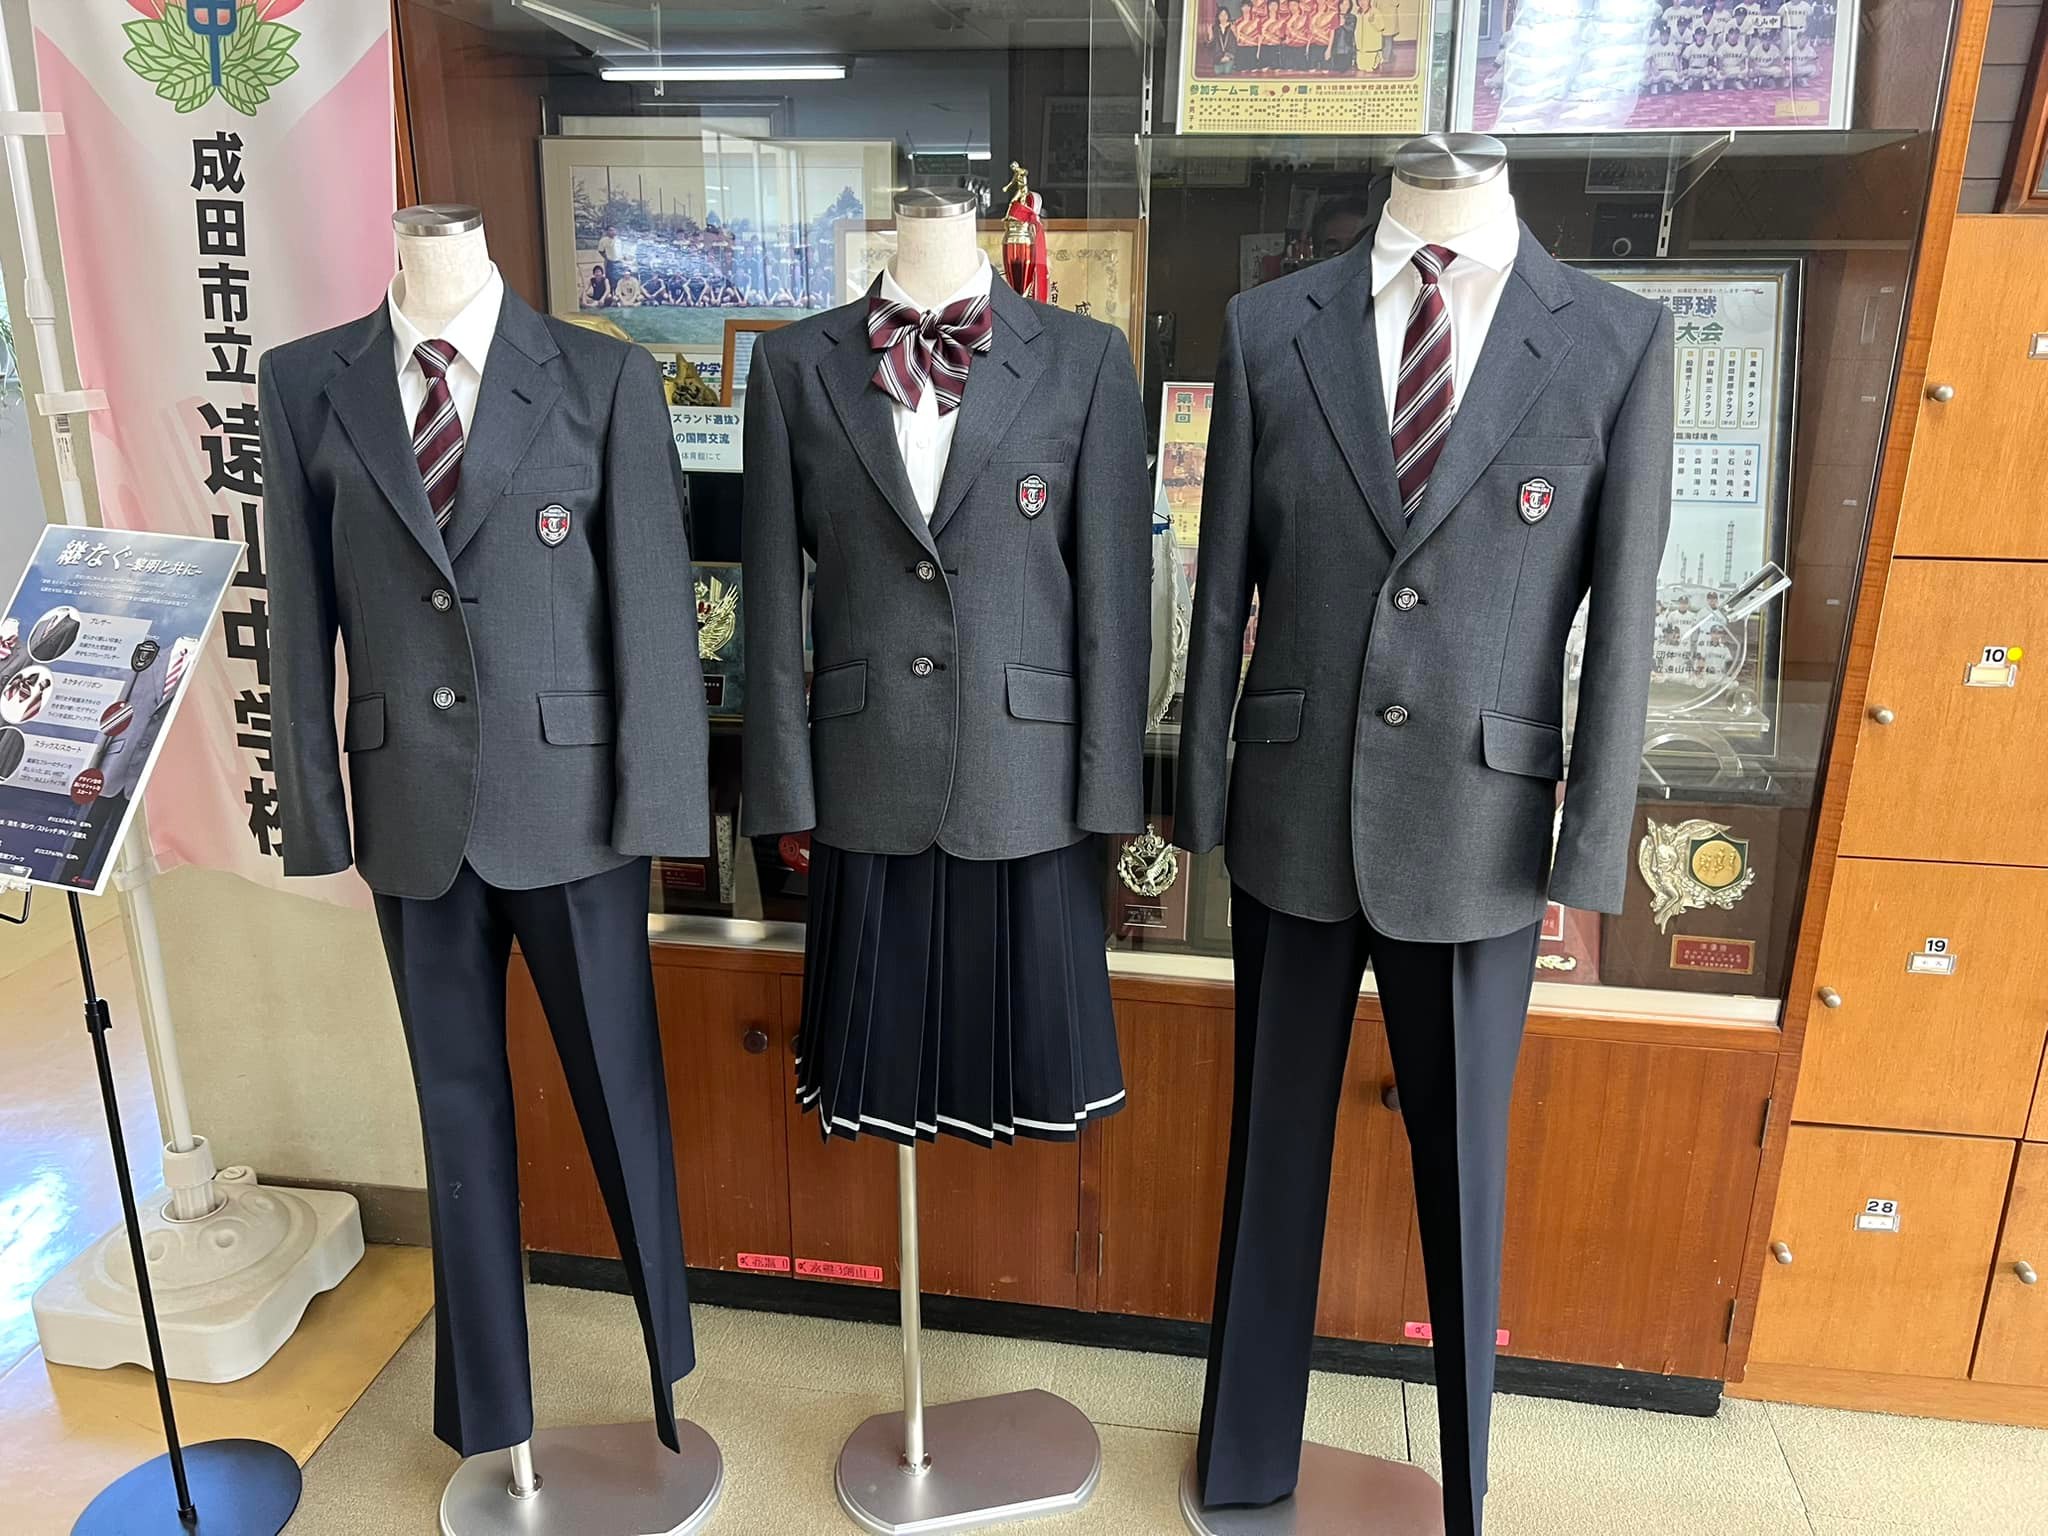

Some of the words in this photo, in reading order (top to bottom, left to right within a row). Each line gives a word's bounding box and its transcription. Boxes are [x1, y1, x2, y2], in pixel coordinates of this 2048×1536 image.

[1676, 322, 1724, 343] 大会
[675, 432, 730, 444] の国際交流
[55, 539, 133, 571] 継なぐ
[1984, 648, 2004, 663] 10
[1927, 939, 1946, 952] 19
[1867, 1200, 1894, 1213] 28
